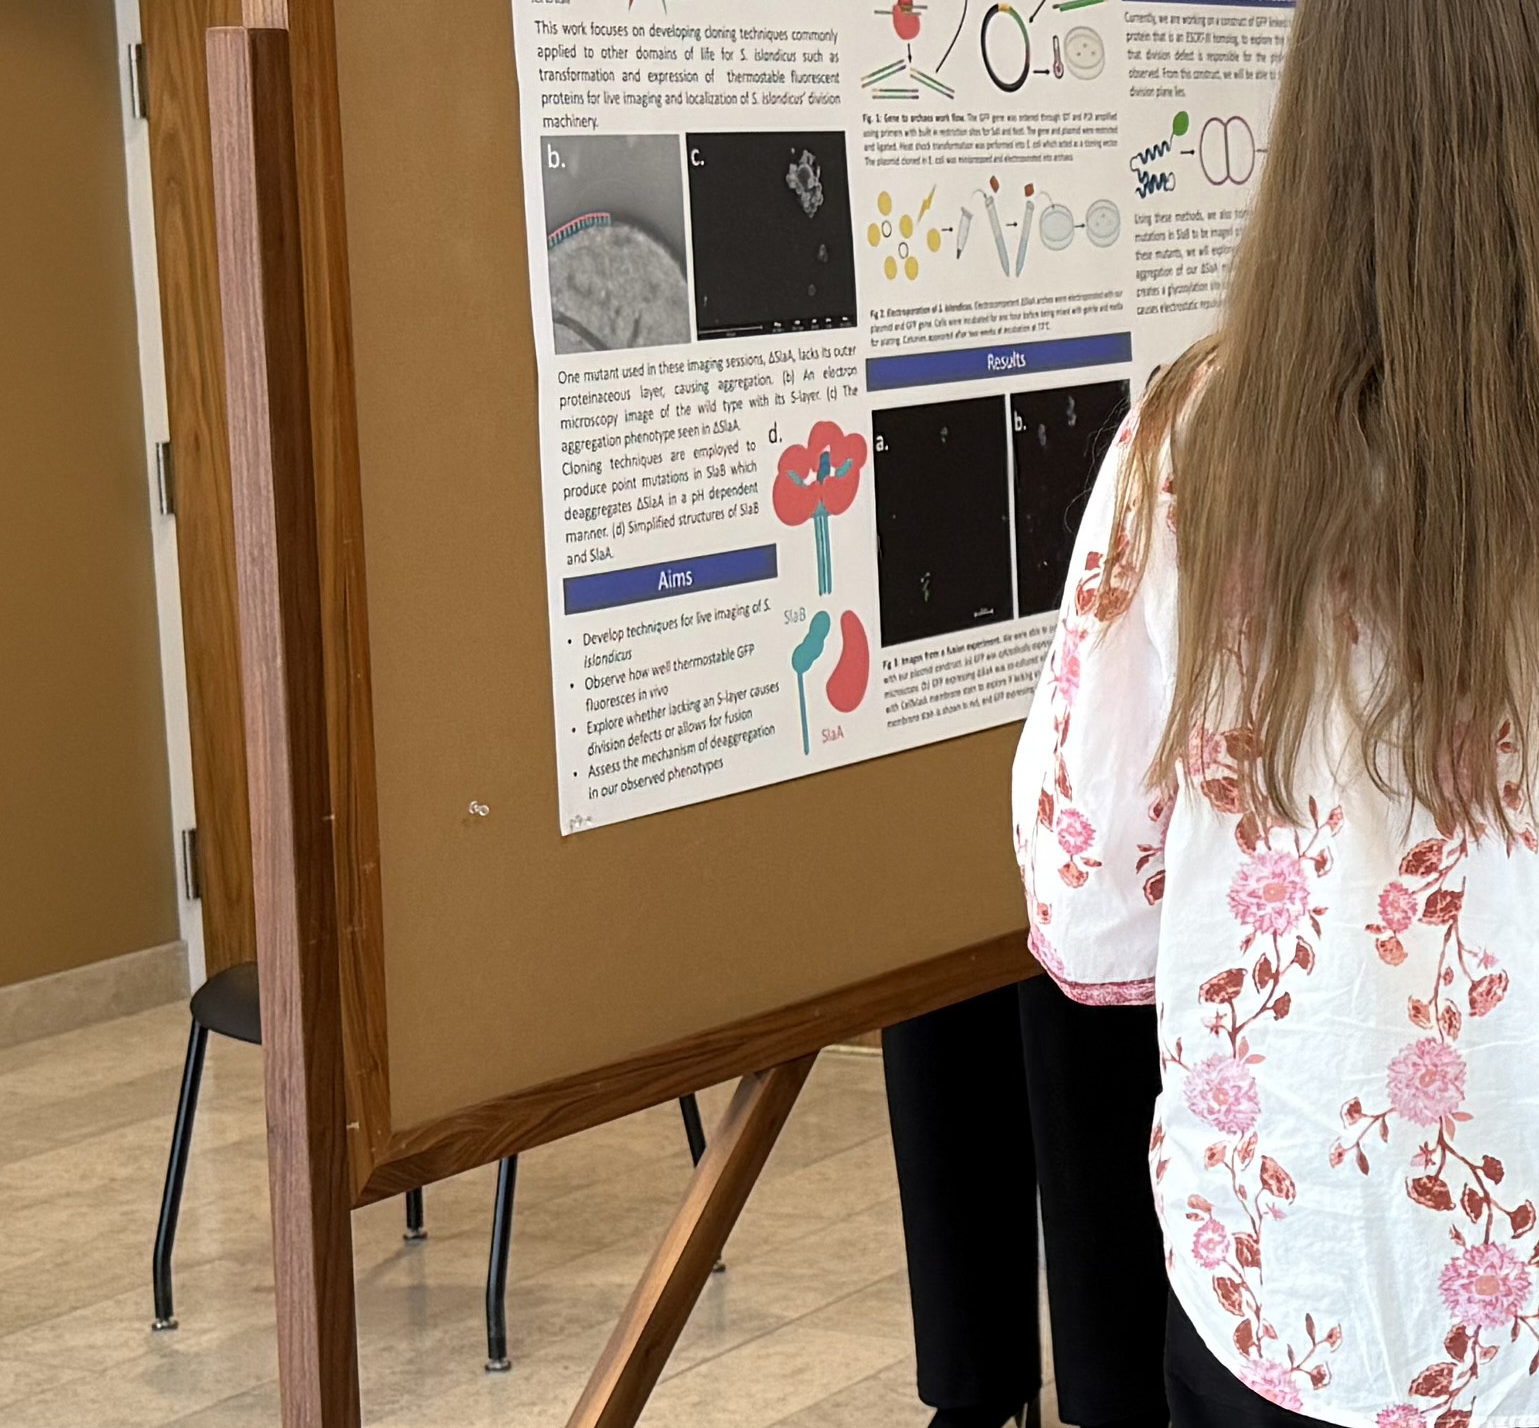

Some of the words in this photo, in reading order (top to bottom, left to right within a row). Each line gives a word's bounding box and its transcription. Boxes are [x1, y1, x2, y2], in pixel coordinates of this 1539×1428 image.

[534, 19, 557, 34] This
[562, 21, 586, 35] work
[590, 21, 628, 36] focuses
[632, 26, 645, 36] on
[649, 23, 701, 41] developing
[704, 25, 736, 42] cloning
[739, 26, 788, 42] techniques
[791, 29, 837, 44] commonly
[537, 43, 576, 60] applied
[583, 46, 594, 58] to
[600, 45, 628, 59] other
[635, 45, 677, 60] domains
[684, 45, 693, 60] of
[700, 46, 714, 61] life
[720, 46, 733, 61] for
[802, 49, 822, 62] such
[829, 52, 838, 63] as
[538, 67, 614, 81] transformation
[621, 68, 640, 82] and
[647, 70, 698, 84] expression
[704, 68, 714, 83] of
[726, 69, 785, 83] thermostable
[790, 69, 839, 83] fluorescent
[541, 91, 584, 107] proteins
[586, 90, 600, 104] for
[603, 90, 620, 104] live
[623, 91, 662, 108] imaging
[665, 91, 682, 105] and
[685, 91, 737, 105] localization
[740, 91, 749, 105] of
[808, 91, 840, 104] division
[547, 143, 566, 169] b.
[690, 146, 705, 167] c.
[986, 351, 1026, 372] Results
[768, 421, 783, 444] d.
[1013, 409, 1027, 433] b.
[875, 434, 889, 453] a.
[567, 549, 587, 565] and
[589, 546, 613, 562] SlaA
[658, 569, 694, 592] Aims
[583, 628, 624, 646] Develop
[626, 619, 678, 637] techniques
[680, 613, 693, 626] for
[696, 611, 711, 624] live
[714, 604, 749, 620] imaging
[752, 598, 761, 613] of
[584, 672, 625, 690] Observe
[628, 668, 648, 680] how
[651, 660, 670, 675] well
[673, 648, 734, 671] thermostable
[737, 643, 754, 658] GFP
[585, 692, 635, 711] fluoresces
[638, 688, 647, 700] in
[649, 684, 668, 698] vivo
[587, 717, 623, 734] Explore
[626, 707, 666, 724] whether
[669, 699, 700, 715] lacking
[703, 696, 714, 708] an
[717, 689, 747, 705] S-layer
[749, 682, 779, 697] causes
[587, 738, 625, 756] division
[627, 729, 661, 746] defects
[664, 726, 674, 738] or
[677, 719, 706, 735] allows
[708, 714, 721, 727] for
[724, 709, 752, 723] fusion
[588, 761, 620, 777] Assess
[622, 755, 638, 769] the
[641, 743, 695, 764] mechanism
[698, 736, 707, 751] of
[710, 725, 775, 748] deaggregation
[588, 786, 598, 799] in
[601, 783, 618, 797] our
[620, 769, 665, 791] observed
[667, 758, 723, 782] phenotypes
